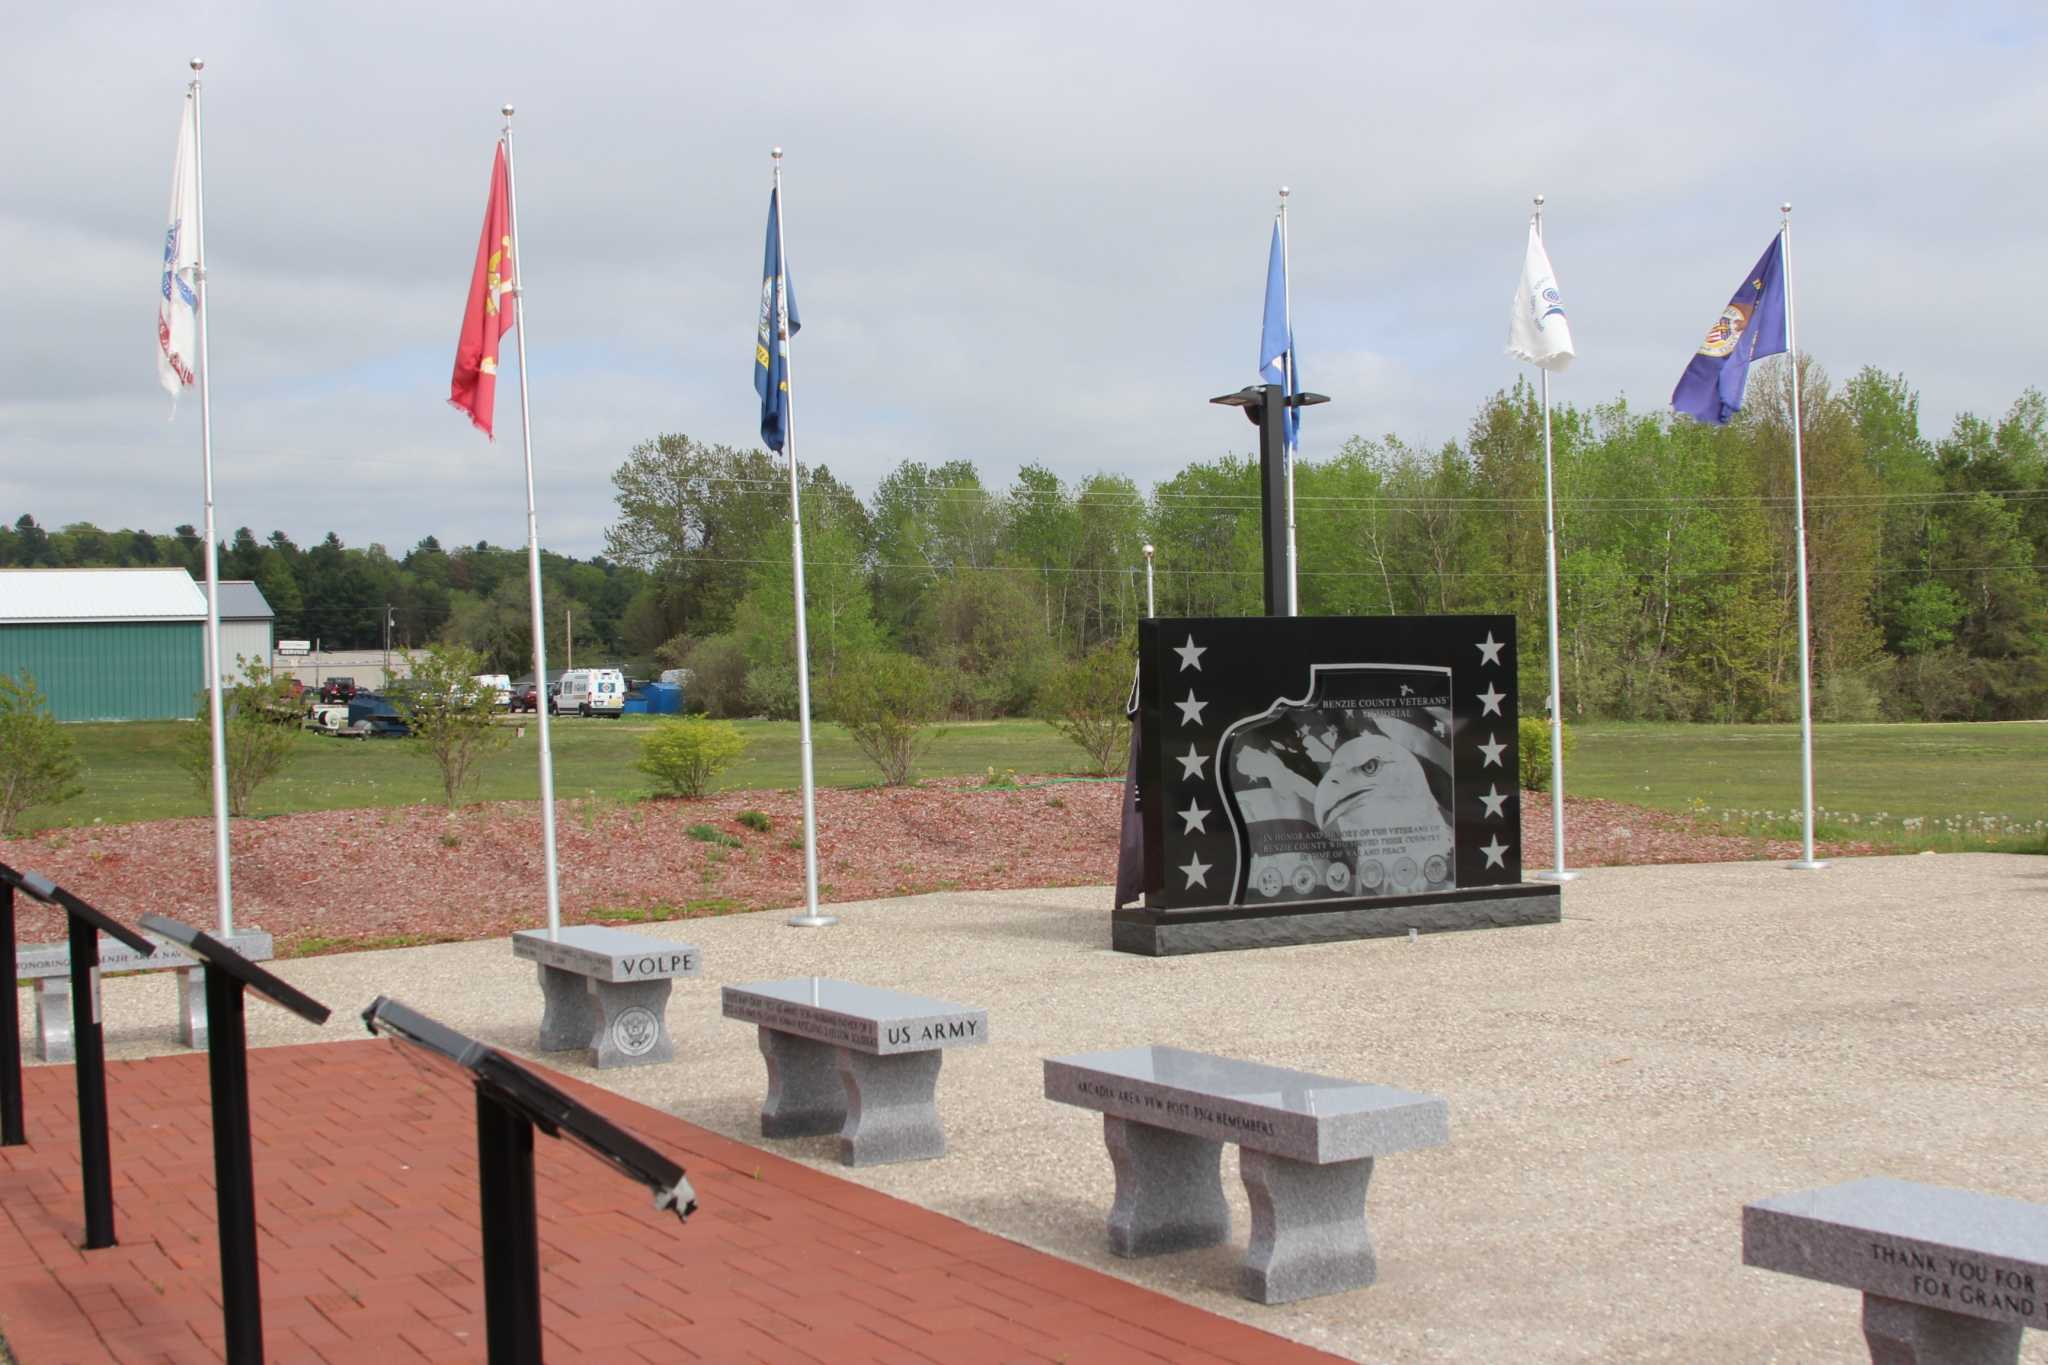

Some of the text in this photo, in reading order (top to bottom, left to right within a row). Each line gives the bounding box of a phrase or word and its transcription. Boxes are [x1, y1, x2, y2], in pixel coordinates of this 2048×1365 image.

[1322, 699, 1357, 709] BENZIE
[1358, 698, 1397, 708] COUNTY
[622, 953, 693, 976] VOLPE
[887, 1019, 979, 1045] US ARMY
[1216, 1111, 1274, 1137] REMEMBERS
[1871, 1243, 2036, 1294] THANK YOU FOR
[1913, 1275, 1951, 1298] FOX
[1959, 1286, 2035, 1317] GRAND
